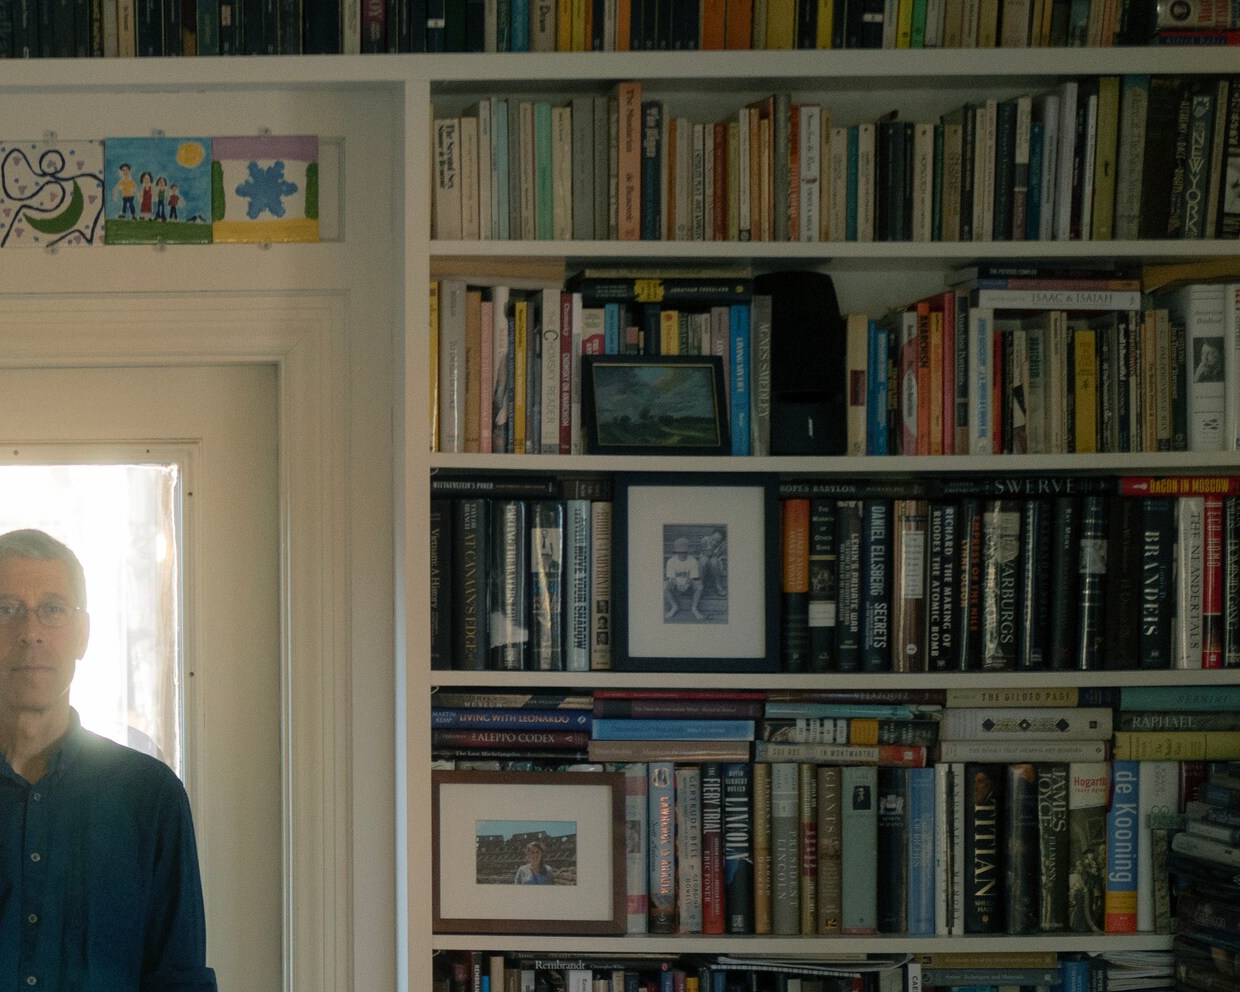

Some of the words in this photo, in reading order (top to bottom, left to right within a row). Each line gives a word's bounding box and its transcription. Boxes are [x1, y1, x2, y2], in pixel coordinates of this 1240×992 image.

[995, 480, 1074, 494] SWERVE
[1150, 479, 1177, 493] BACON
[1180, 479, 1188, 493] IN
[1192, 479, 1229, 493] MOSCOW
[464, 533, 476, 547] AT
[870, 506, 885, 541] DANIEL
[932, 511, 941, 552] RHODES
[944, 508, 953, 555] RICHARD
[1190, 512, 1200, 538] THE
[574, 546, 586, 574] MOVE
[870, 545, 885, 596] ELLSBERG
[932, 557, 941, 577] THE
[944, 563, 952, 583] THE
[574, 577, 587, 602] YOUR
[931, 581, 941, 622] ATOMIC
[1144, 531, 1160, 636] BRANDEIS
[1190, 545, 1200, 648] NEANDERTALS
[873, 603, 887, 648] SECRETS
[943, 587, 952, 630] MAKING
[465, 617, 477, 654] EDGE
[574, 606, 586, 649] SHADOW
[931, 626, 940, 656] BOMB
[942, 634, 952, 647] OF
[459, 714, 490, 722] LIVING
[492, 714, 516, 722] WITH
[519, 715, 570, 723] LEONARDO
[478, 734, 515, 742] ALEPPO
[518, 734, 555, 743] CODEX
[703, 778, 720, 805] FIERY
[1038, 769, 1053, 828] JOYCE
[1052, 768, 1066, 832] JAMES
[1116, 771, 1136, 794] de
[825, 772, 835, 833] GIANTS
[703, 808, 720, 834] TRIAL
[725, 797, 751, 863] LINCOLN
[974, 799, 996, 896] TITIAN
[1109, 803, 1136, 882] Kooning
